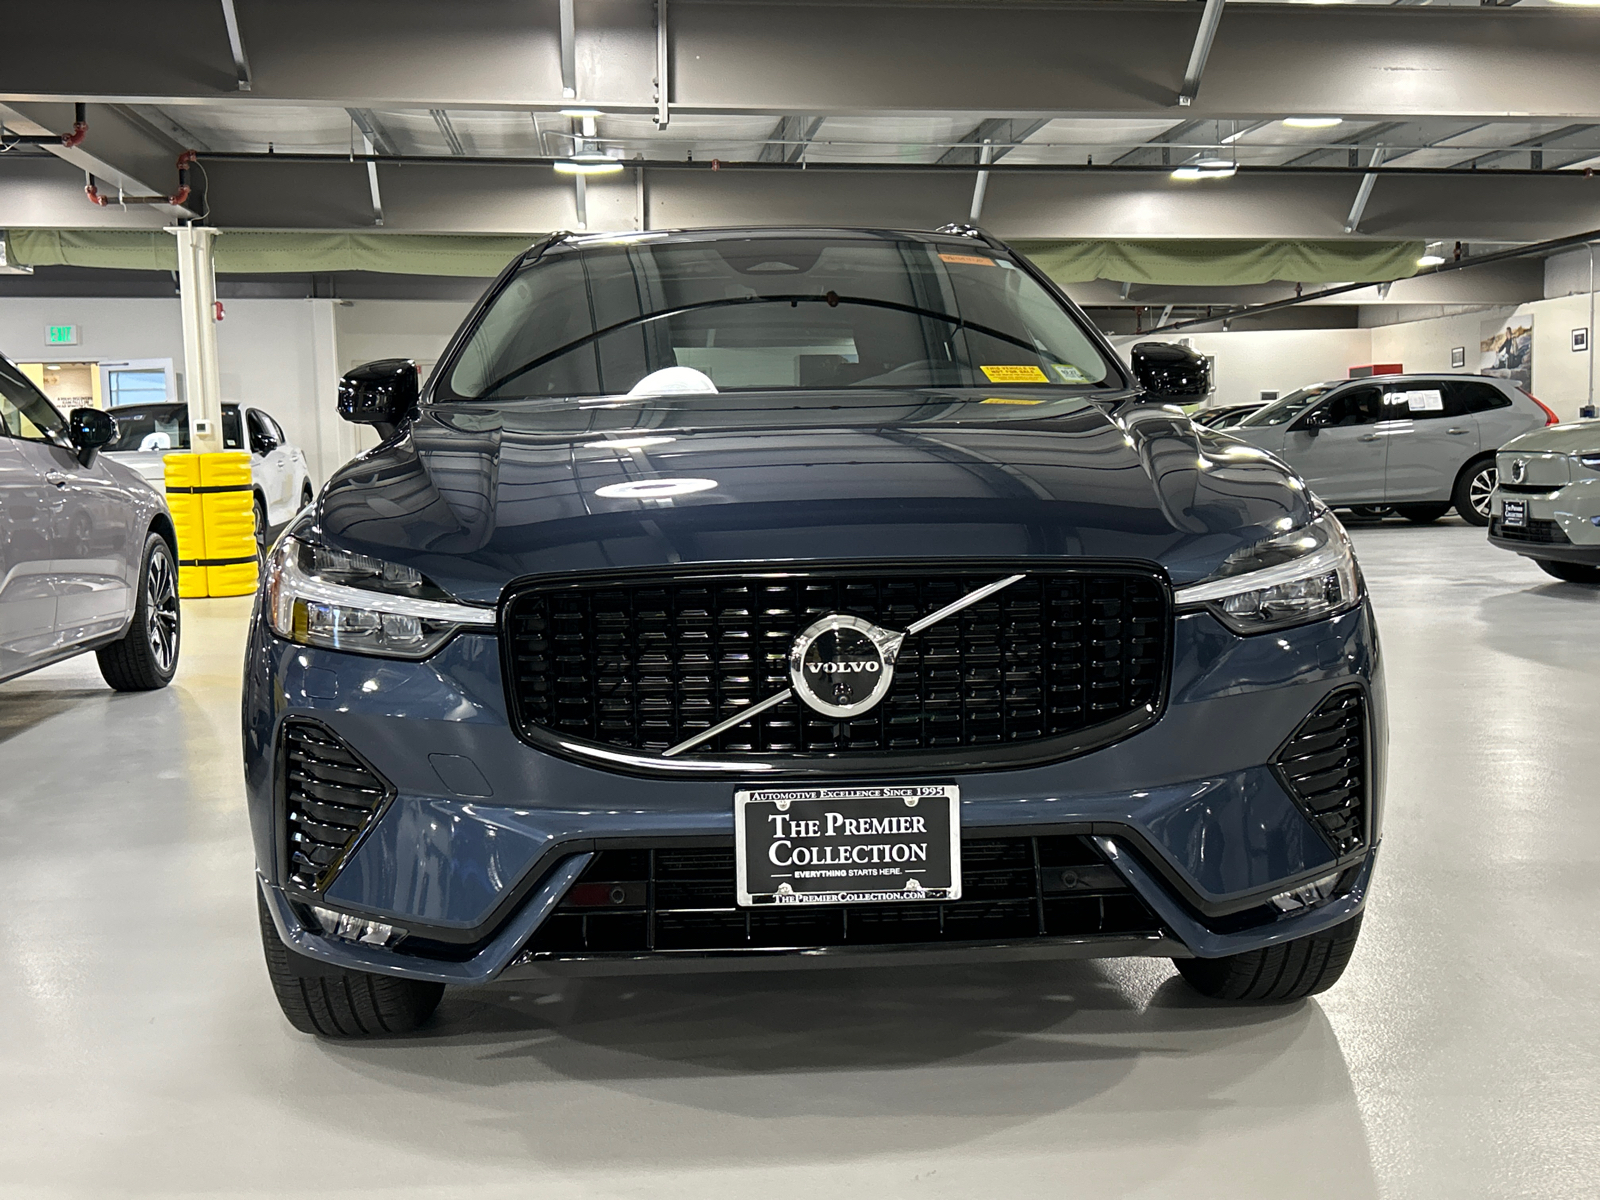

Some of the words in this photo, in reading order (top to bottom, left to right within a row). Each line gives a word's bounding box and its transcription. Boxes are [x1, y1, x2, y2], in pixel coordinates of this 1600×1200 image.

[50, 326, 72, 342] EXIT
[805, 660, 880, 674] VOLVO
[751, 790, 817, 801] AUTOMOTIVE
[820, 789, 881, 799] EXCELLENCE
[883, 788, 913, 797] SINCE
[916, 787, 944, 796] 1995
[768, 813, 821, 838] THE
[824, 812, 927, 836] PREMIER
[768, 839, 928, 866] COLLECTION
[794, 869, 847, 879] EVERYTHING
[848, 868, 878, 877] STARTS
[879, 867, 903, 876] HERE.
